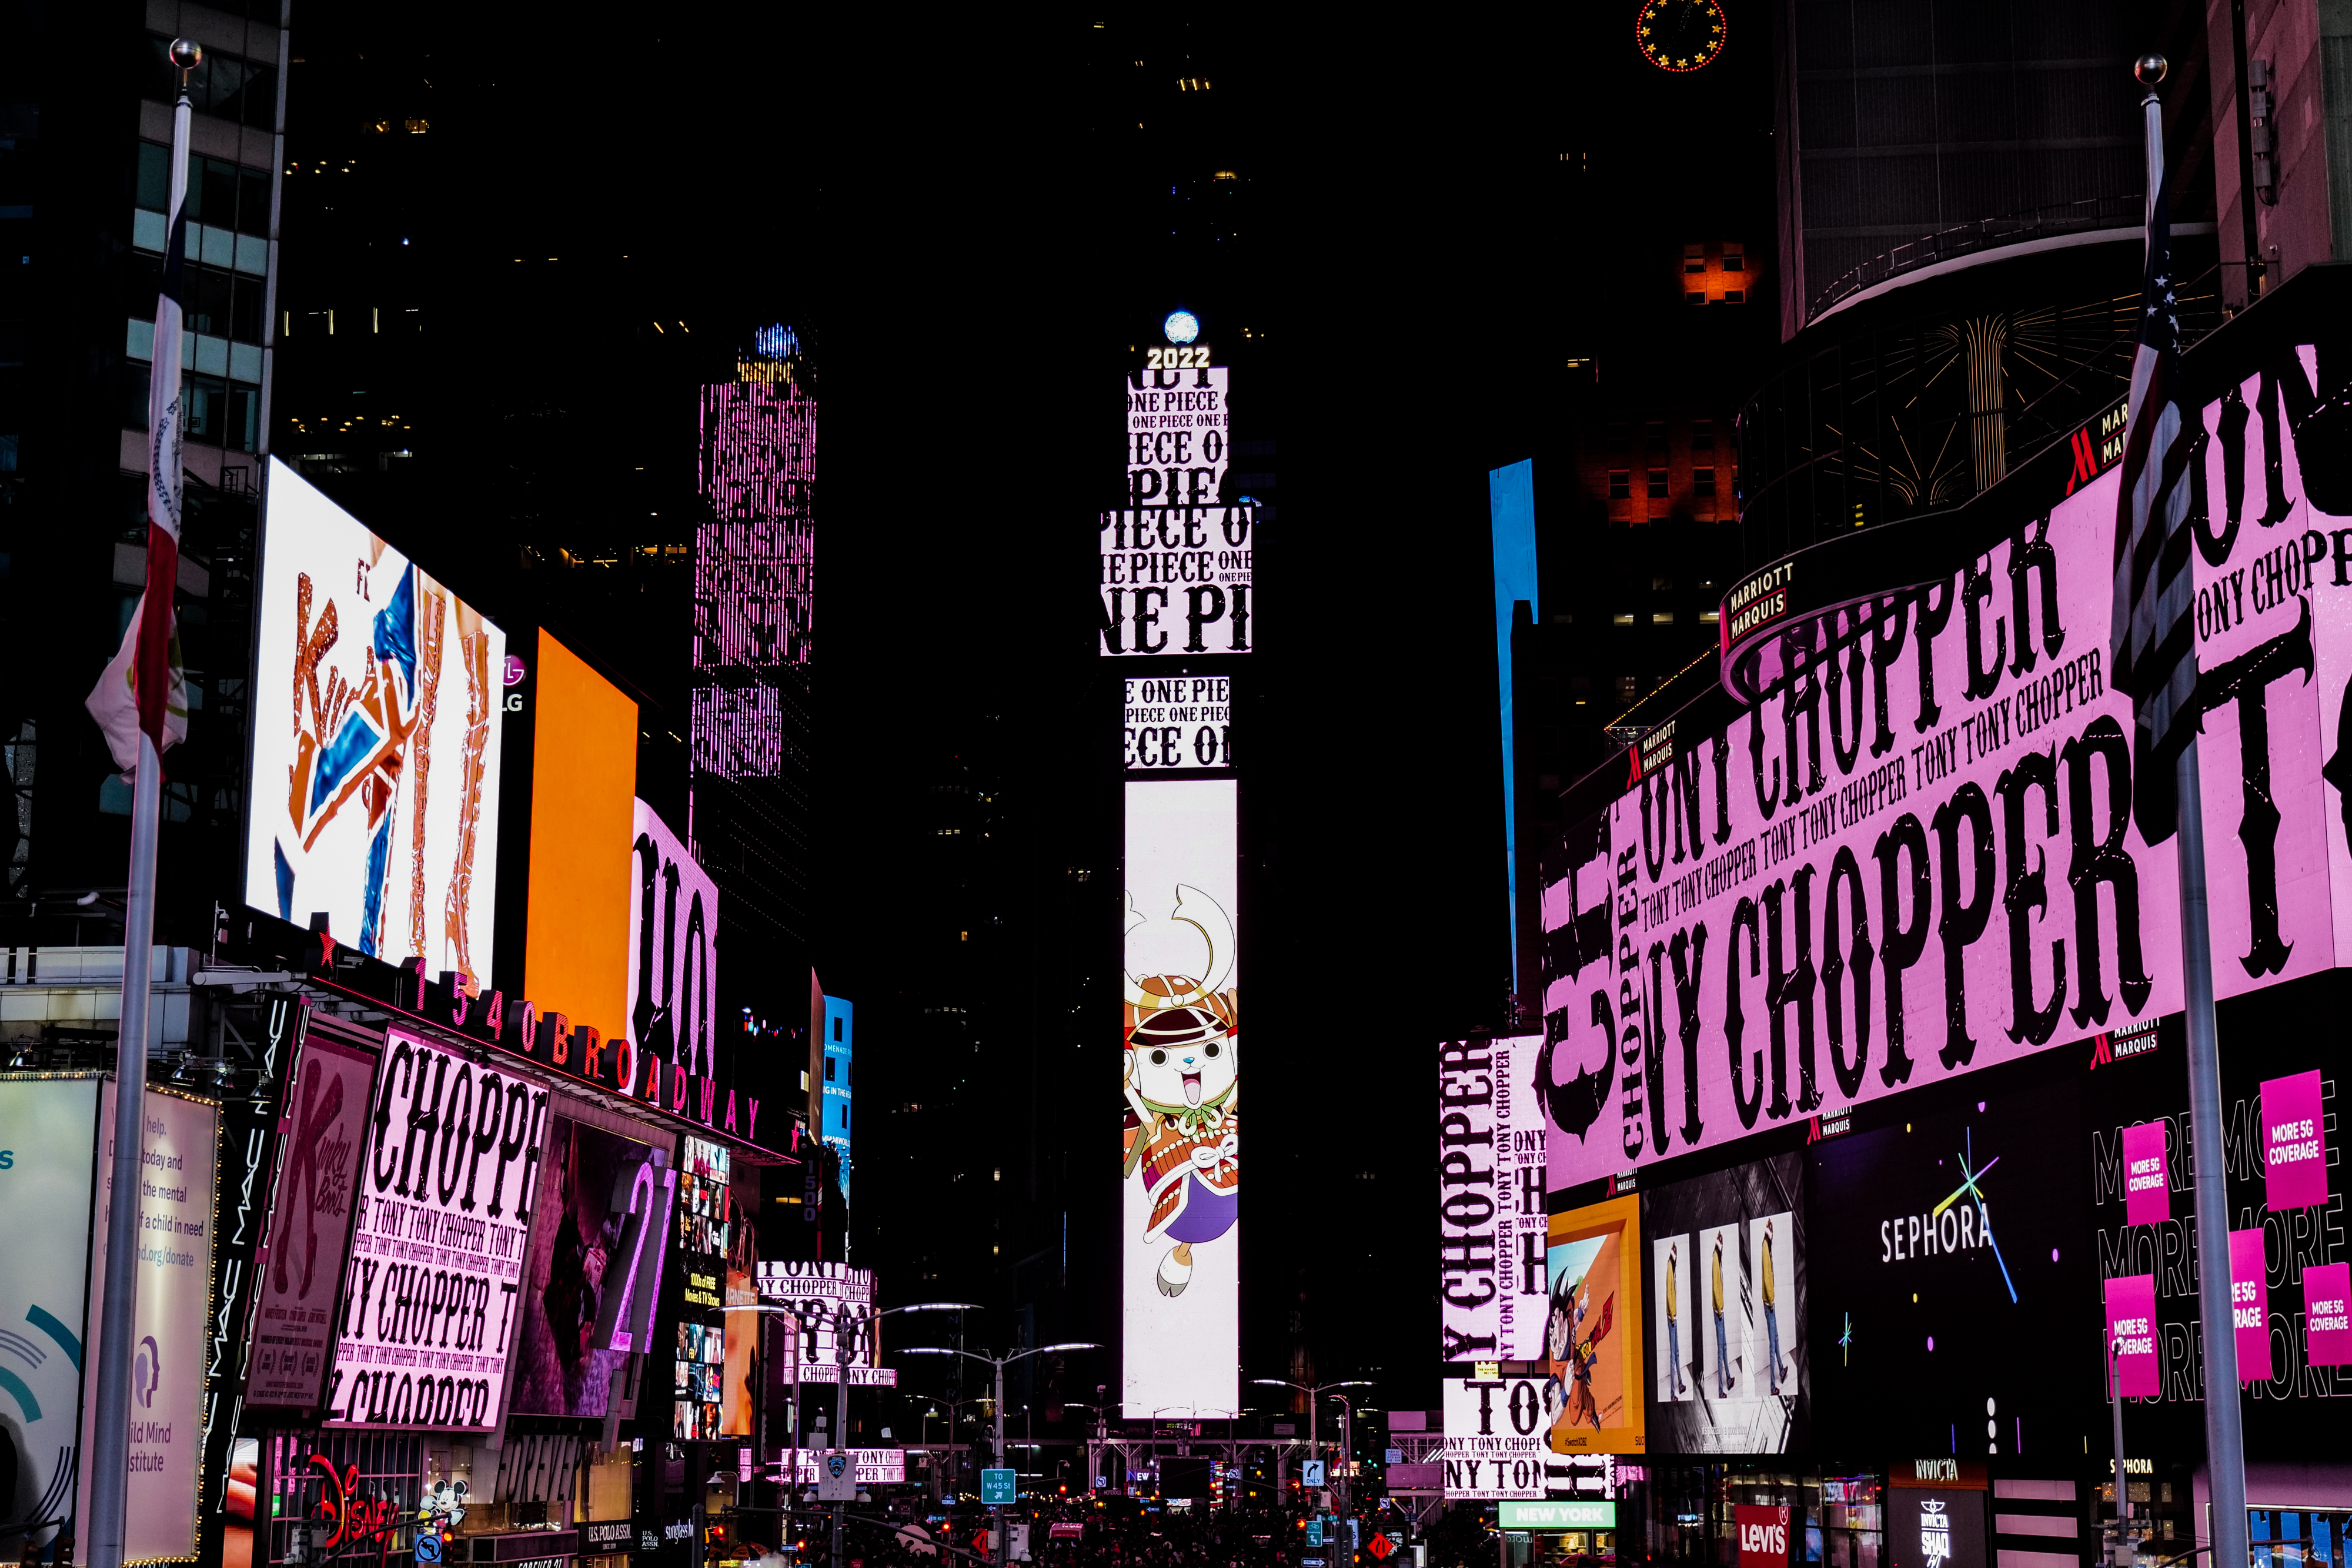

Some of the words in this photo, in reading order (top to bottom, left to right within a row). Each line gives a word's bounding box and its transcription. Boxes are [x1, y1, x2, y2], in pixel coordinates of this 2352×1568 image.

[1148, 347, 1210, 369] 2022
[1164, 390, 1218, 412] PIECE
[1132, 415, 1157, 428] ONE
[1159, 414, 1193, 427] PIECE
[1197, 414, 1221, 426] ONE
[1128, 551, 1214, 584] PIECE
[1731, 562, 1793, 613] MARRIOTT
[1732, 594, 1785, 640] MARQUIS
[1141, 680, 1186, 703] ONE
[1125, 707, 1165, 723] PIECE
[1169, 707, 1197, 722] ONE
[1643, 720, 1676, 754] MARRIOTT
[1643, 742, 1672, 773] MARQUIS
[1641, 888, 1671, 932] TONY
[1672, 867, 1703, 917] TONY
[1705, 848, 1758, 910] CHOPPER
[1760, 815, 1797, 870] TONY
[1798, 791, 1838, 850] TONY
[1839, 754, 1908, 840] CHOPPER
[1911, 726, 1958, 791] TONY
[1961, 697, 2012, 765] TONY
[2015, 647, 2104, 738] CHOPPER
[1723, 714, 2154, 1131] CHOPPER
[412, 956, 536, 1052] 1540
[1616, 838, 1645, 1161] CHOPPER
[2115, 1035, 2157, 1058] MARQUIS
[546, 1011, 759, 1139] BROADWAY
[1496, 1050, 1510, 1119] CHOPPER
[147, 1115, 166, 1139] help.
[1823, 1118, 1850, 1136] MARQUIS
[2271, 1121, 2298, 1144] MORE
[2300, 1119, 2314, 1138] 5G
[1496, 1123, 1511, 1166] TONY
[2269, 1139, 2320, 1166] COVERAGE
[142, 1146, 165, 1171] today
[167, 1154, 183, 1171] and
[2130, 1158, 2150, 1177] MORE
[2150, 1157, 2160, 1172] 5G
[143, 1179, 156, 1198] the
[159, 1185, 187, 1203] mental
[804, 1160, 816, 1221] 1500
[1497, 1170, 1512, 1213] TONY
[1617, 1179, 1636, 1192] MARQUIS
[2129, 1172, 2164, 1192] COVERAGE
[145, 1216, 151, 1229] a
[152, 1213, 173, 1233] child
[175, 1216, 182, 1233] in
[184, 1220, 204, 1237] need
[373, 1195, 407, 1237] TONY
[408, 1205, 441, 1243] TONY
[439, 1212, 487, 1252] CHOPPER
[489, 1221, 517, 1259] TONY
[1882, 1202, 1993, 1263] SEPHORA
[374, 1236, 392, 1256] TONY
[392, 1239, 409, 1259] TONY
[408, 1242, 434, 1265] CHOPPER
[436, 1248, 451, 1266] TONY
[451, 1250, 466, 1269] TONY
[466, 1253, 489, 1273] CHOPPER
[490, 1258, 505, 1276] TONY
[505, 1260, 520, 1279] TONY
[606, 1161, 677, 1354] 21
[1498, 1219, 1513, 1289] CHOPPER
[690, 1272, 702, 1288] 1000s
[702, 1275, 706, 1288] of
[706, 1275, 716, 1290] FREE
[780, 1279, 837, 1295] CHOPPER
[2241, 1280, 2256, 1301] 5G
[377, 1262, 490, 1352] CHOPPER
[685, 1288, 699, 1303] Movies
[699, 1290, 702, 1304] &
[702, 1291, 708, 1305] TV
[707, 1292, 720, 1307] Shows
[726, 1288, 755, 1305] ARNETTE
[2311, 1300, 2329, 1317] MORE
[2329, 1299, 2344, 1315] 5G
[1499, 1293, 1514, 1338] TONY
[2113, 1319, 2133, 1336] MORE
[2133, 1317, 2148, 1334] 5G
[2310, 1315, 2348, 1333] COVERAGE
[356, 1344, 375, 1363] TONY
[375, 1346, 392, 1365] TONY
[392, 1348, 417, 1368] CHOPPER
[418, 1350, 435, 1368] TONY
[435, 1352, 450, 1370] TONY
[450, 1354, 473, 1372] CHOPPER
[475, 1356, 490, 1373] TONY
[489, 1358, 505, 1375] TONY
[146, 1422, 171, 1443] Mind
[1468, 1437, 1502, 1450] TONY
[1565, 1438, 1587, 1446] #SwatchXDBZ
[1127, 1469, 1149, 1480] NEW
[1915, 1459, 1959, 1482] INVICTA
[2110, 1459, 2153, 1475] SPHORA
[1516, 1507, 1556, 1522] NEW
[1558, 1507, 1603, 1522] YORK
[1920, 1513, 1949, 1529] INVICTA
[589, 1526, 599, 1542] U.S.
[599, 1525, 614, 1540] POLO
[615, 1524, 632, 1540] ASSN.
[665, 1519, 688, 1544] sunglass
[1921, 1531, 1950, 1558] SHAQ
